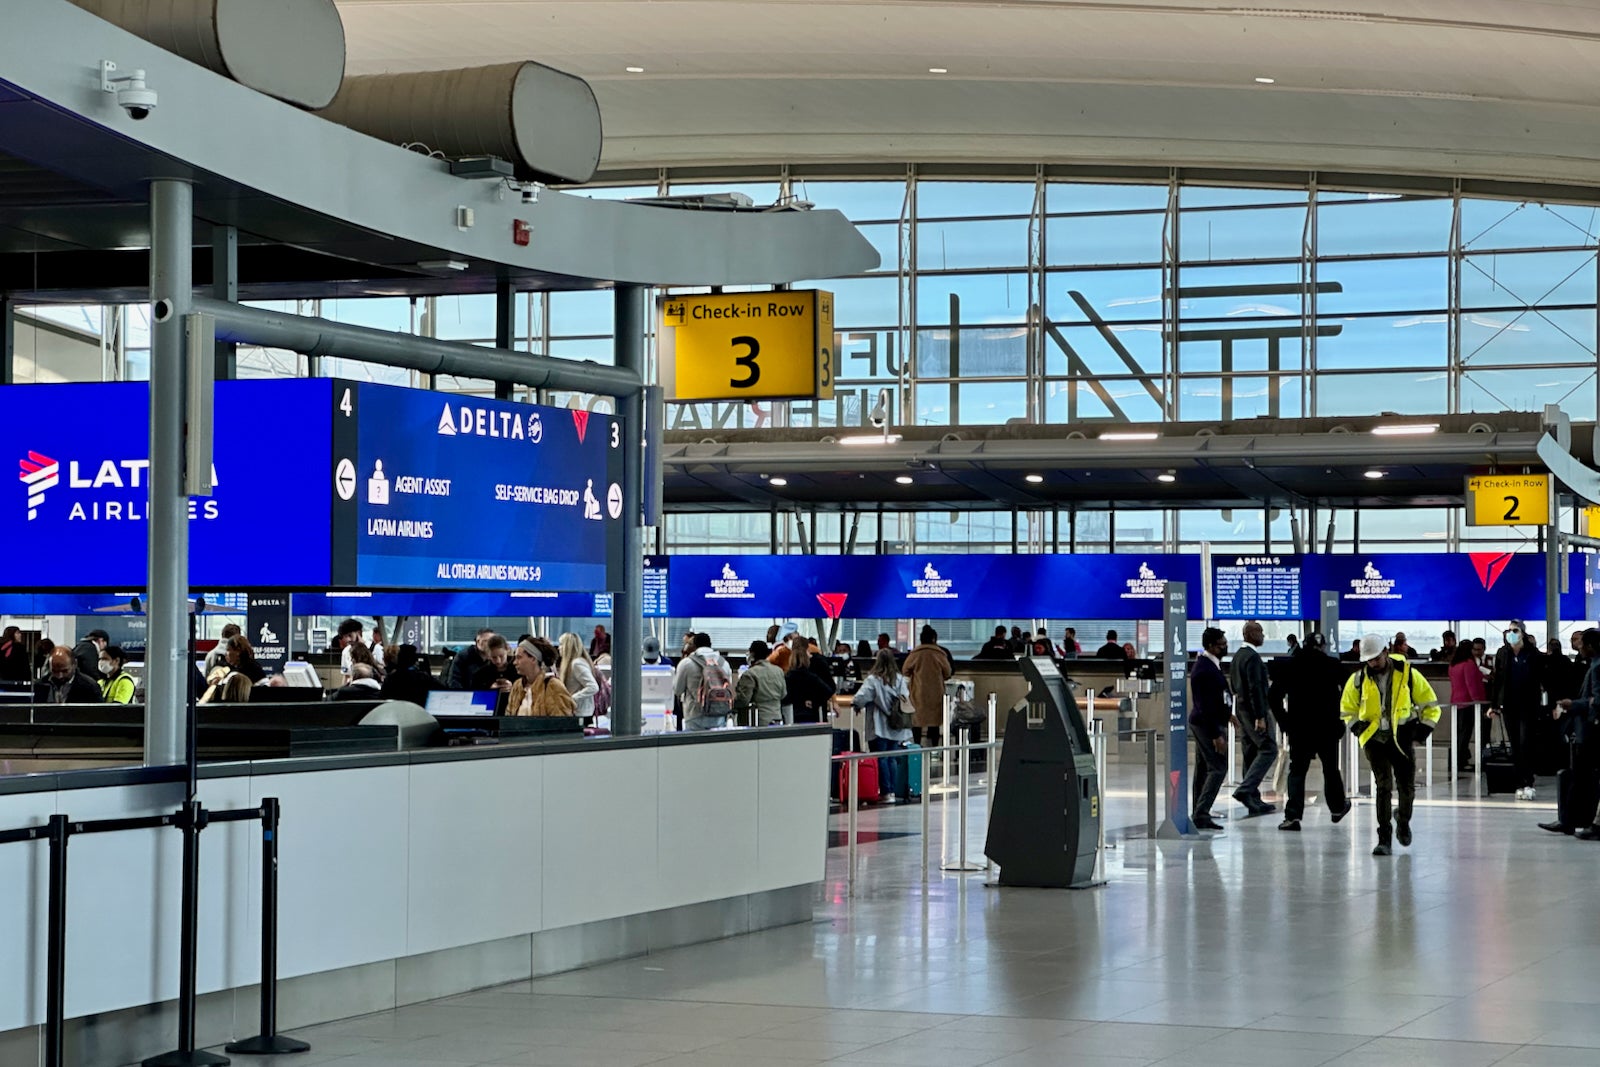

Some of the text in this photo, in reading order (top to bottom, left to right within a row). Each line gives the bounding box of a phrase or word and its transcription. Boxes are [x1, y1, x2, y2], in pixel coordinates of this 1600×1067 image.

[692, 302, 804, 319] Check-in Row
[730, 335, 760, 388] 3
[821, 348, 830, 387] 3
[340, 388, 352, 417] 4
[460, 406, 524, 440] DELTA
[610, 421, 620, 449] 3
[70, 460, 219, 488] LAT
[1484, 479, 1544, 489] Check-in Row
[395, 475, 451, 496] AGENT ASSIST
[495, 484, 580, 506] SELF-SERVICE BAG DROP
[69, 500, 219, 520] AIRLIES
[1503, 495, 1520, 521] 2
[368, 518, 434, 539] LATAM AIRLINES
[1244, 557, 1273, 565] DELTA
[437, 563, 542, 582] ALL OTHER AIRLINES ROWS 5-9
[1350, 579, 1395, 587] SELF-SERVICE
[1355, 586, 1391, 594] BAG DROP
